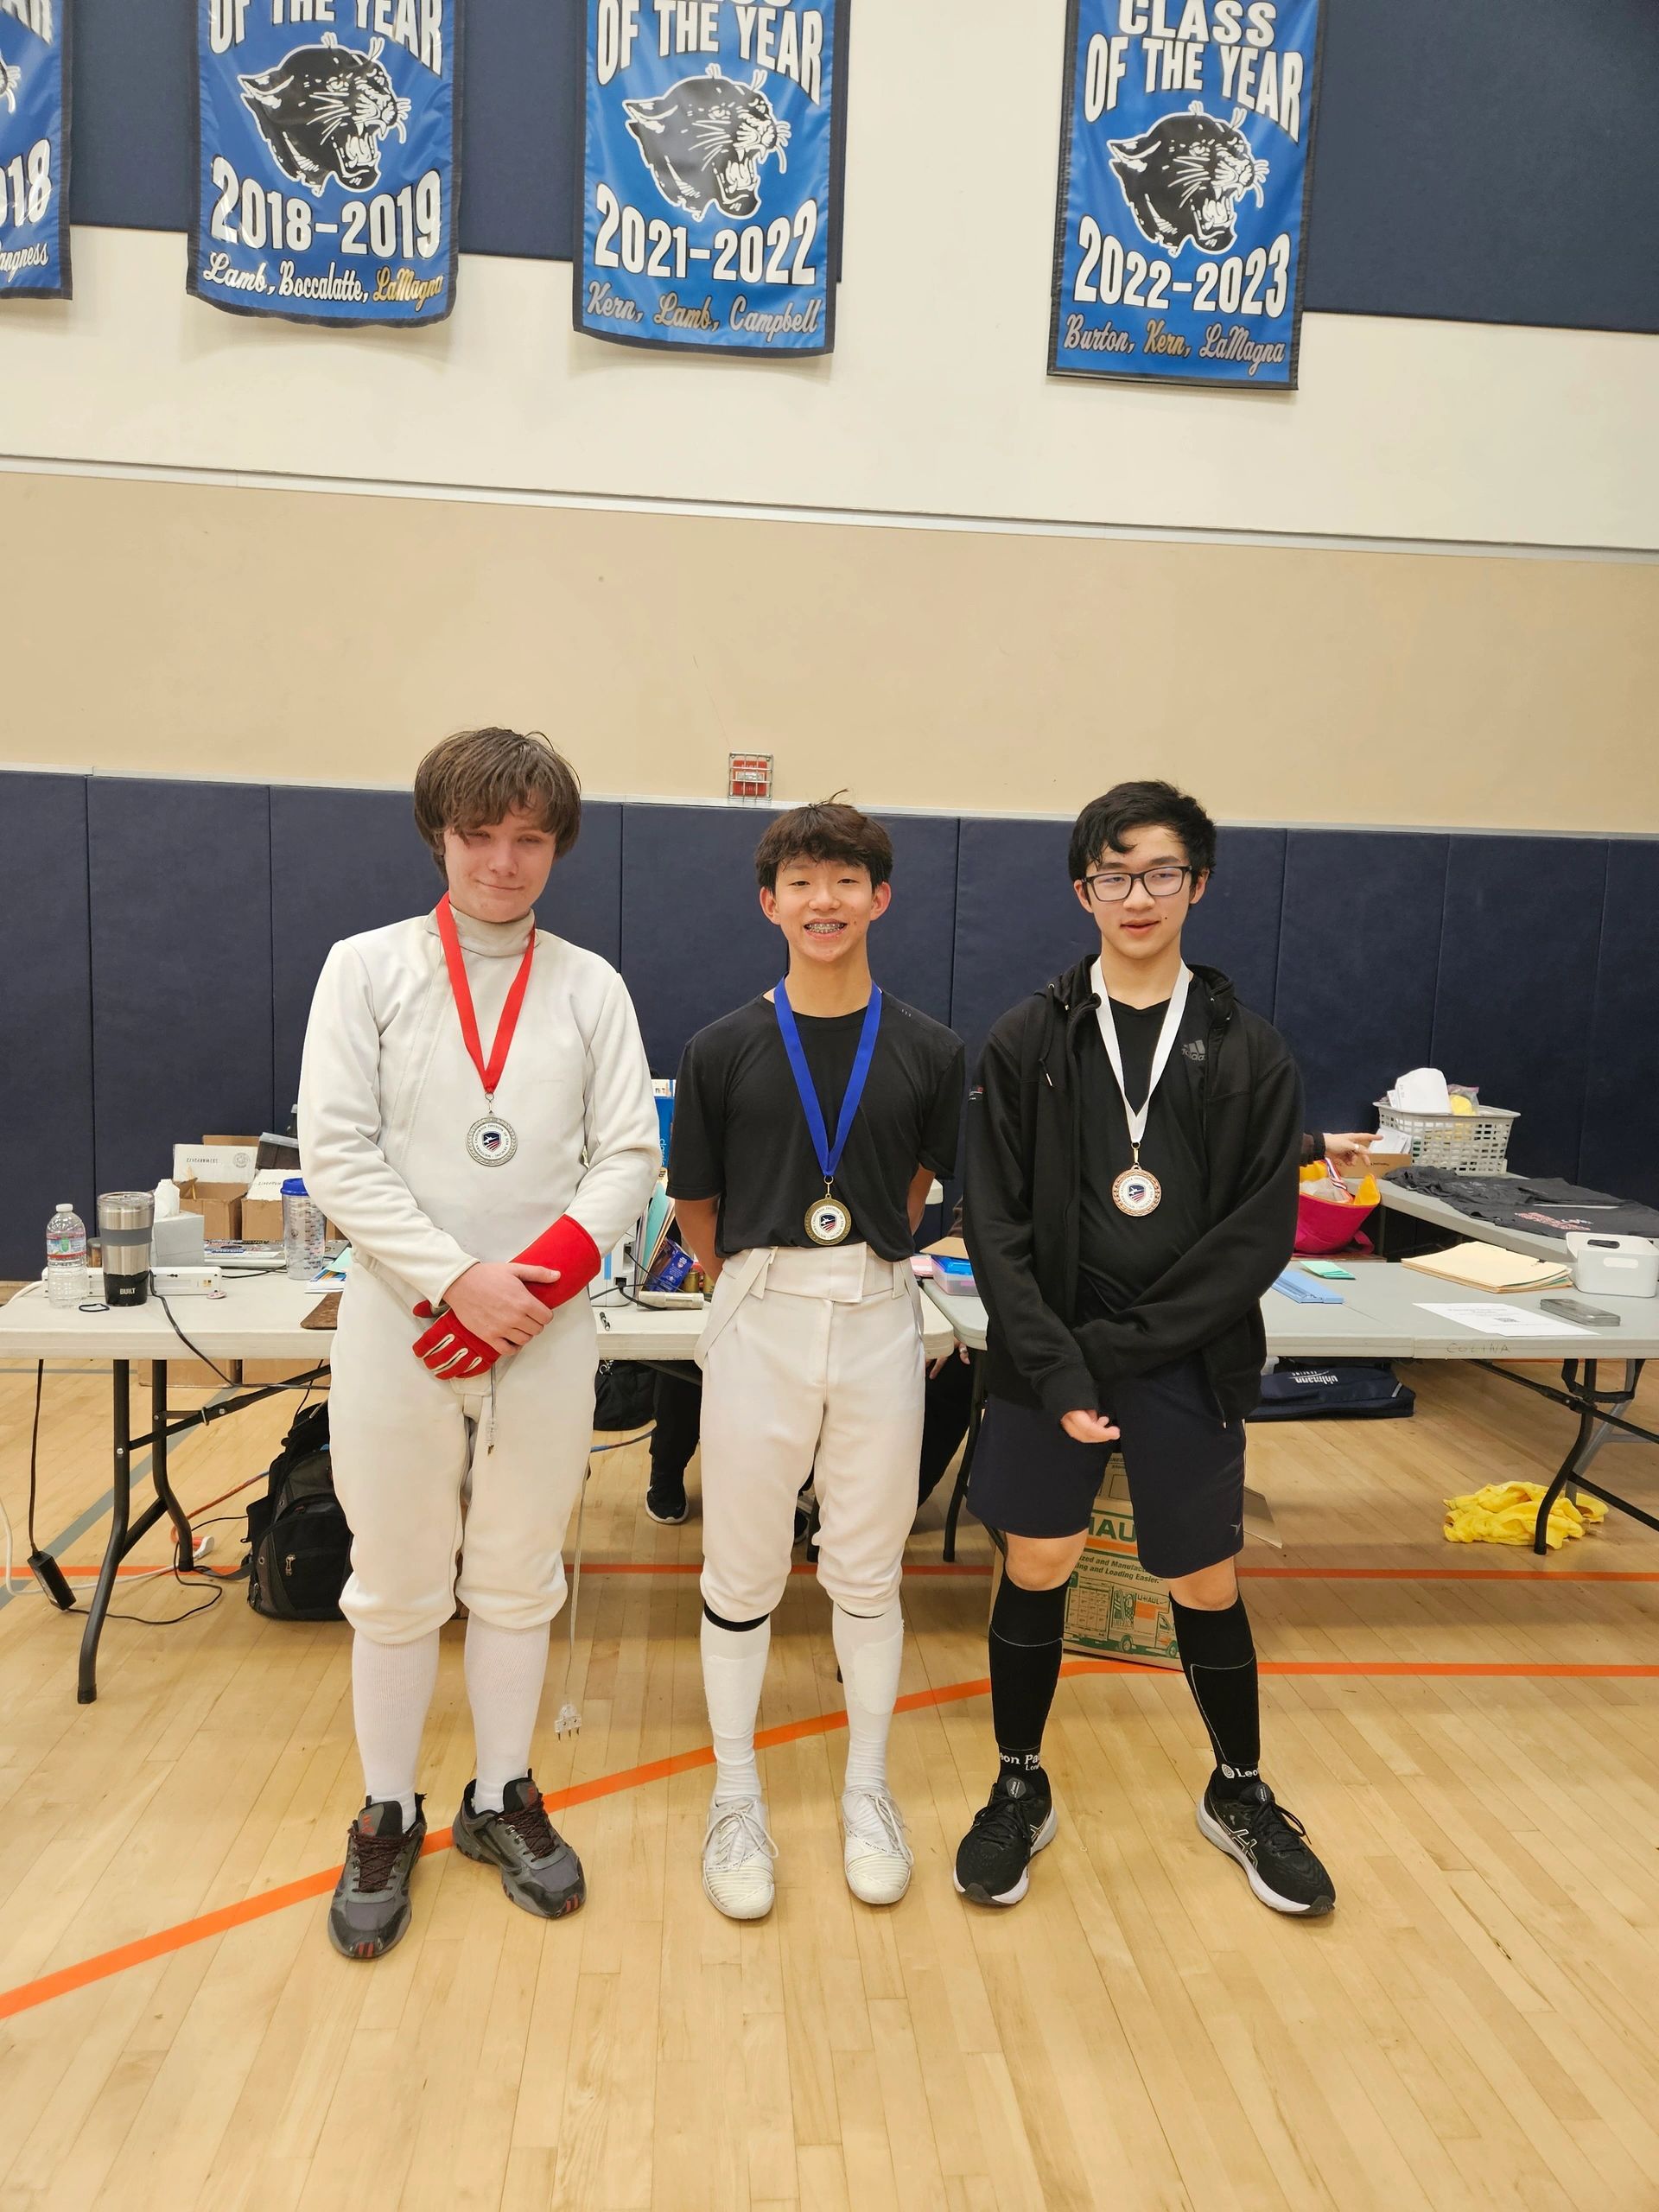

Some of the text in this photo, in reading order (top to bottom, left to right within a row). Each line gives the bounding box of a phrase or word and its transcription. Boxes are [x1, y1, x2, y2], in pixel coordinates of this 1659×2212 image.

[597, 0, 823, 106] OF THE YEAR
[1119, 0, 1277, 48] CLASS
[1084, 34, 1303, 143] OF THE YEAR
[0, 139, 52, 229] 18
[211, 156, 443, 260] 2018-2019
[0, 241, 49, 283] angness
[594, 183, 817, 286] 2021-2022
[203, 251, 445, 312] Lamb, Boccalatte, LaMagna
[1074, 215, 1291, 319] 2022-2023
[588, 281, 822, 343] Kern, Lamb, Campbell
[1064, 314, 1287, 377] Burton, Kern, LaMagna
[119, 1287, 137, 1296] BUILT
[1294, 1375, 1338, 1385] uhlmann
[1096, 1557, 1110, 1566] and
[1110, 1560, 1146, 1573] Manufac
[1105, 1568, 1134, 1580] Loading
[1234, 1767, 1259, 1777] Leo
